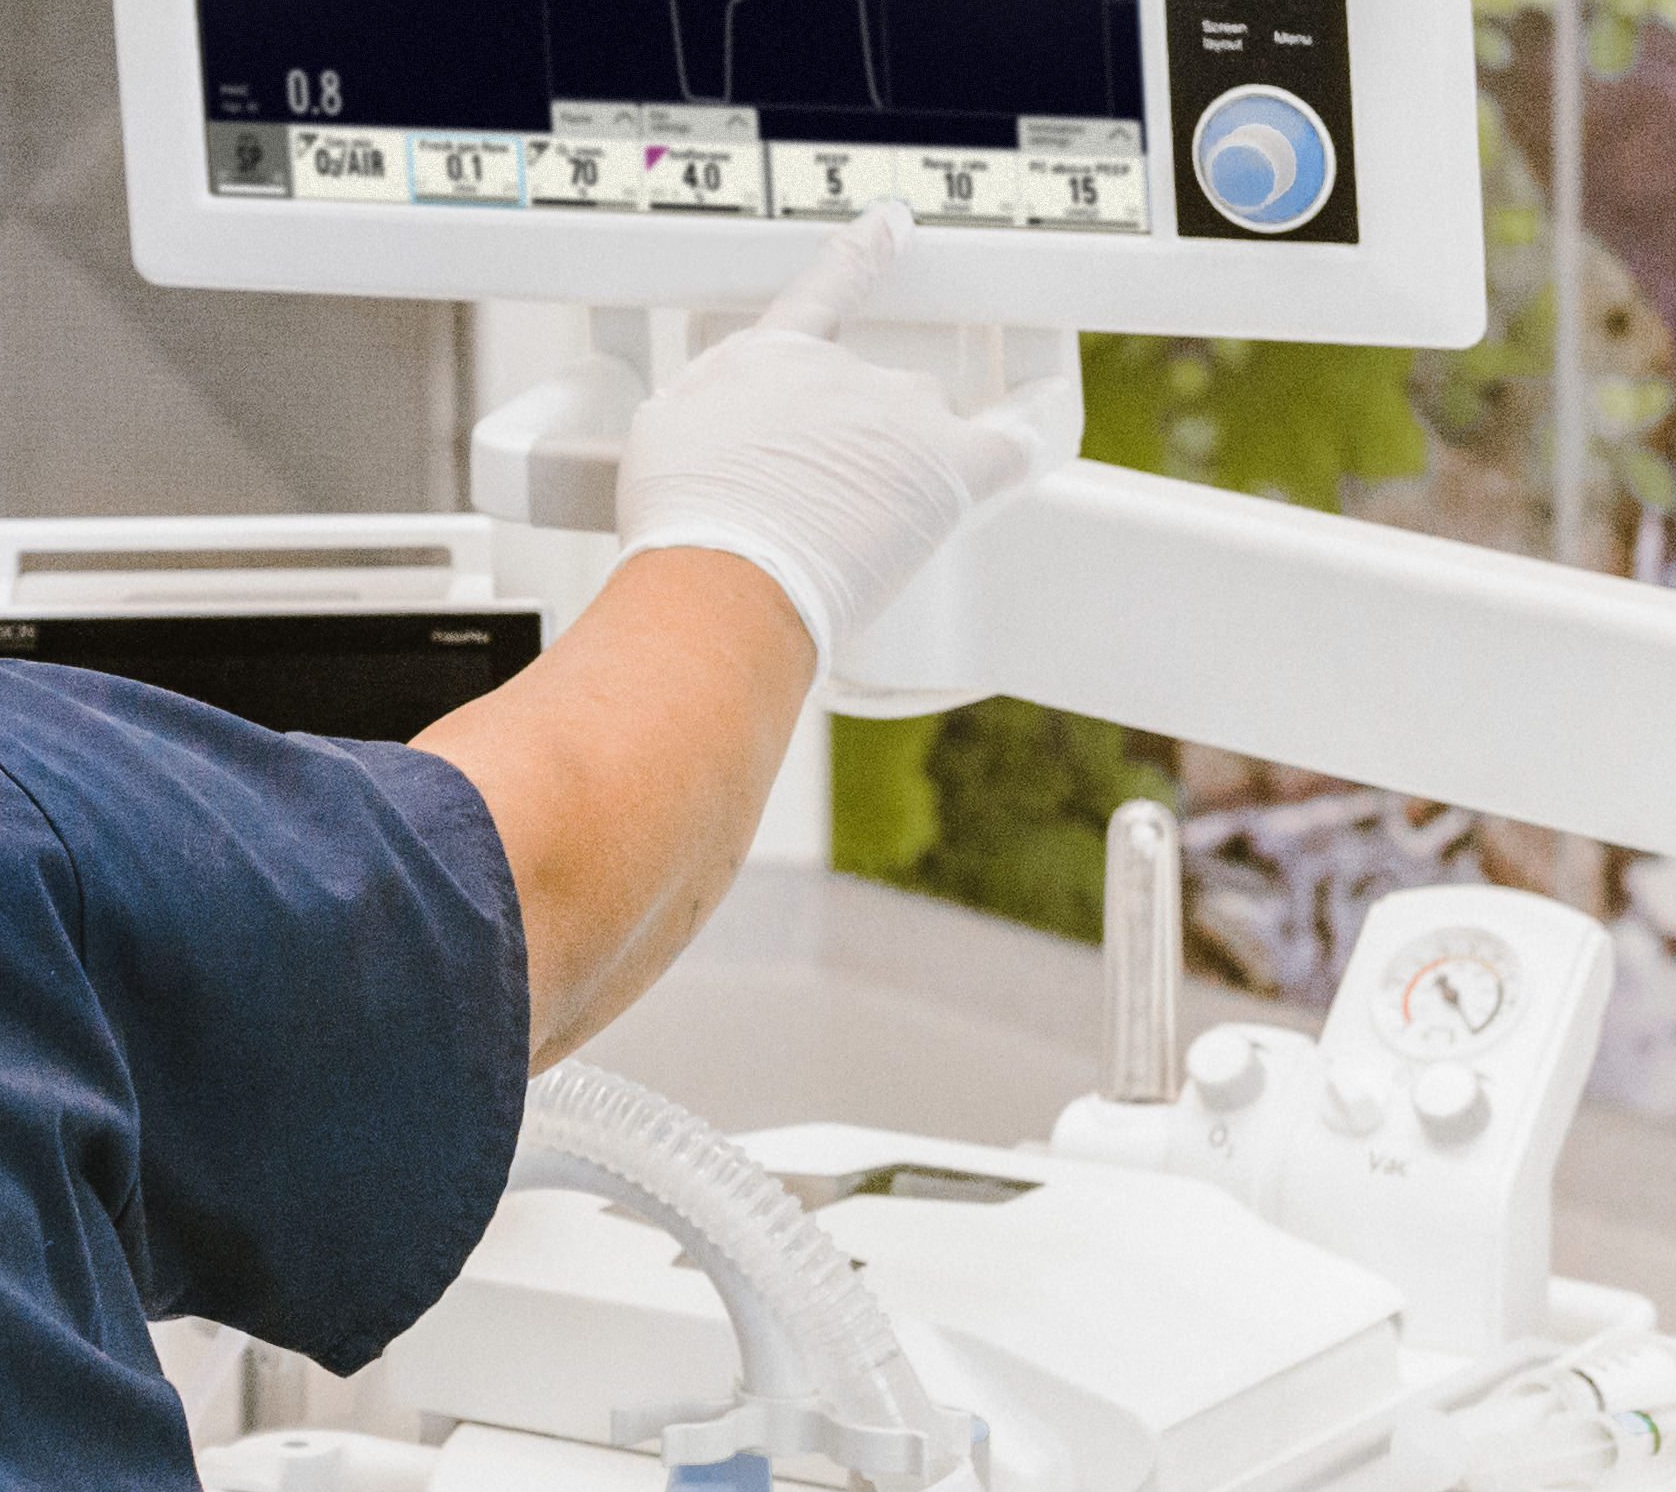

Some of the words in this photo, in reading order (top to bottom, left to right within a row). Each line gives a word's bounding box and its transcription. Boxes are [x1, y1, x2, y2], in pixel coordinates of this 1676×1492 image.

[287, 69, 342, 116] 0.8
[447, 154, 483, 182] 0.1
[570, 158, 599, 187] 70
[683, 163, 721, 192] 4.0
[826, 167, 843, 196] 5
[947, 172, 974, 201] 10
[1069, 176, 1098, 205] 15
